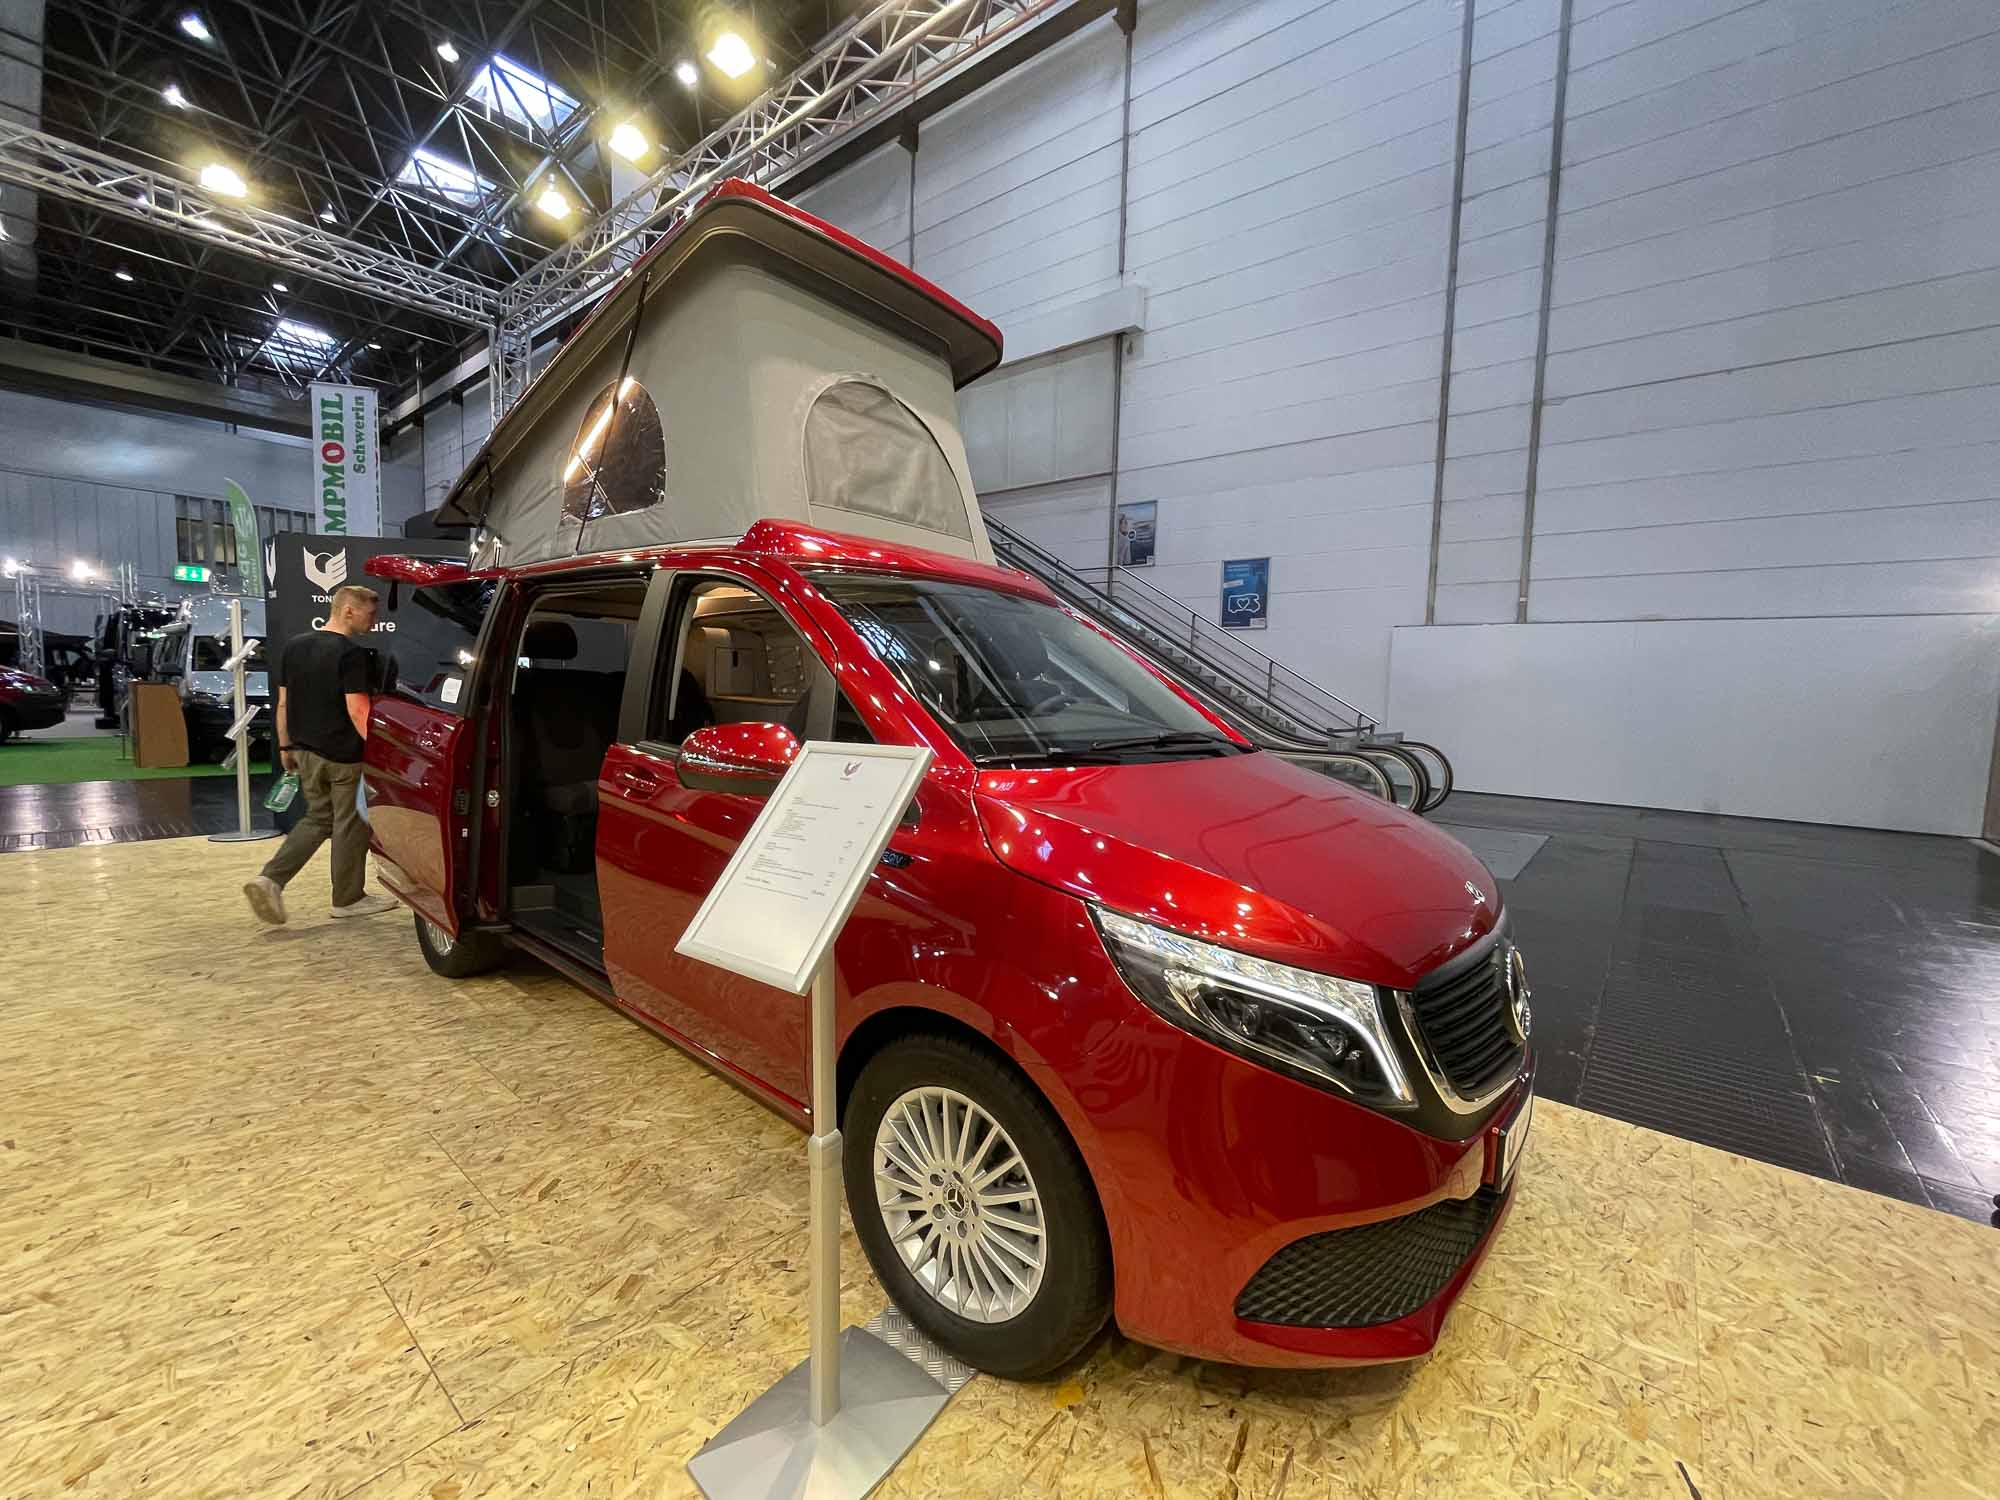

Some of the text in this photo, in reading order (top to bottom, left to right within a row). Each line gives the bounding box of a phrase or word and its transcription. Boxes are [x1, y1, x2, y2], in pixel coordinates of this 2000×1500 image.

[320, 393, 346, 536] MPMOBIL
[352, 395, 367, 474] Schwerin
[312, 595, 335, 603] TON
